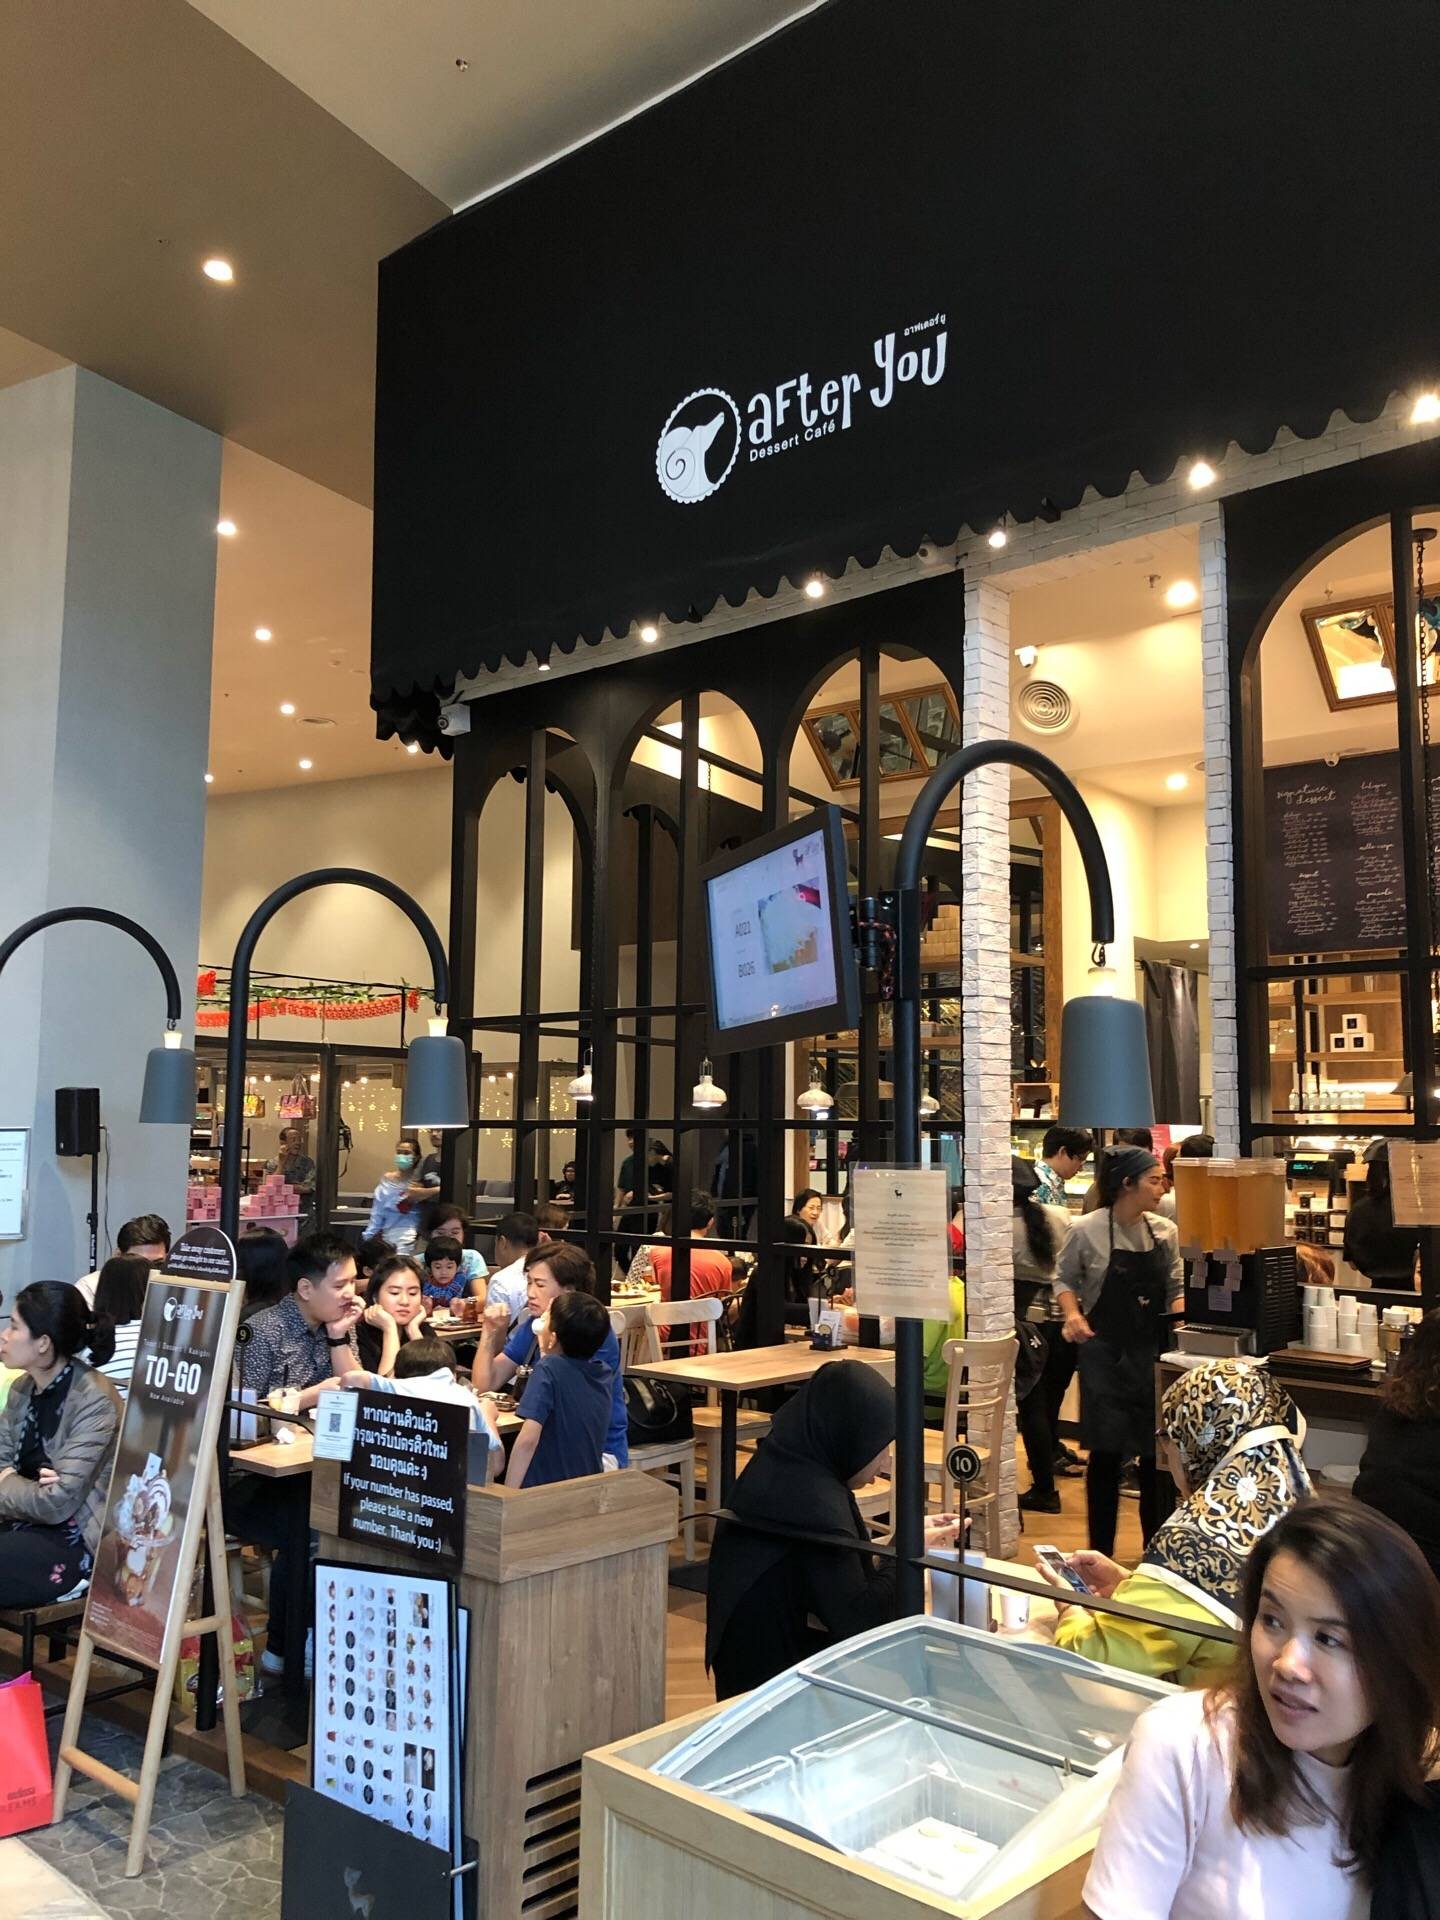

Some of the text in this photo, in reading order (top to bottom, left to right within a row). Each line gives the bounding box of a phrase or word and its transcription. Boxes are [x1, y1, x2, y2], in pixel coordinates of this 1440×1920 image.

[749, 420, 836, 462] Dessert Café
[145, 1354, 202, 1396] TO-GO
[363, 1405, 439, 1434] หากผ่านคิวแล้ว
[955, 1455, 972, 1473] 10
[343, 1472, 454, 1514] If your number has passed,
[360, 1496, 434, 1528] please take a new
[352, 1517, 387, 1536] number.
[389, 1524, 417, 1545] Thank
[416, 1535, 434, 1549] you
